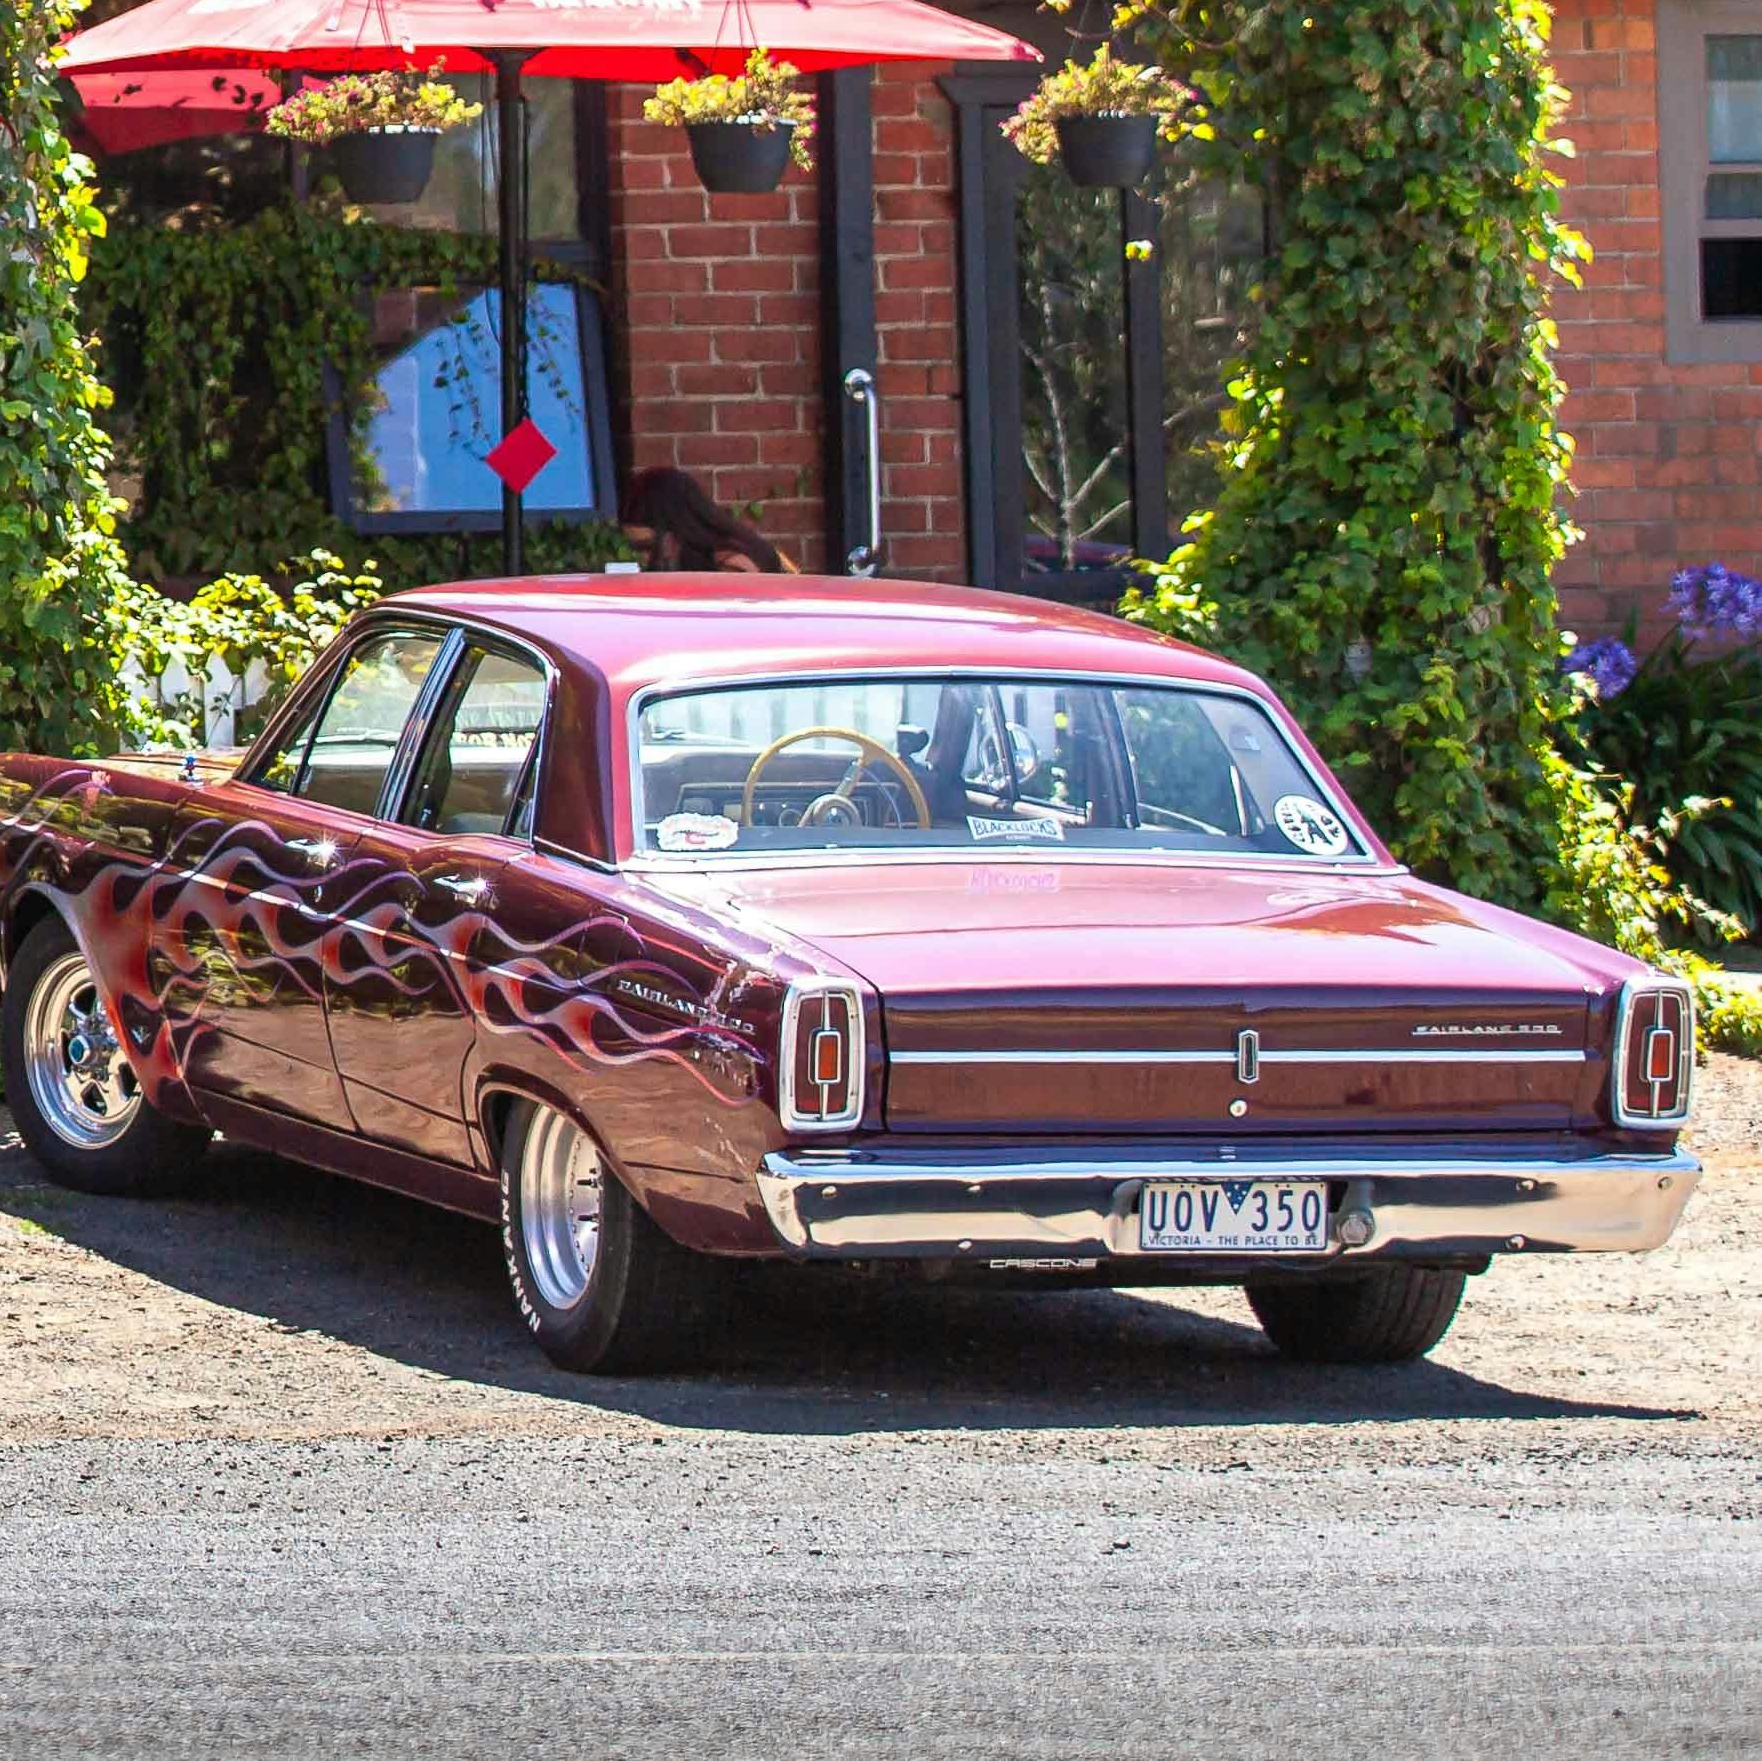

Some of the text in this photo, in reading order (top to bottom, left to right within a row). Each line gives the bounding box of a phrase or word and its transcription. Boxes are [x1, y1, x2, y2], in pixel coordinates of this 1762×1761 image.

[1149, 1189, 1321, 1232] UOV 350
[501, 1168, 541, 1332] NANKANG
[1148, 1234, 1201, 1247] VICTORIA
[1218, 1235, 1238, 1246] THE
[1245, 1235, 1278, 1246] PLACE
[1284, 1235, 1299, 1246] TO
